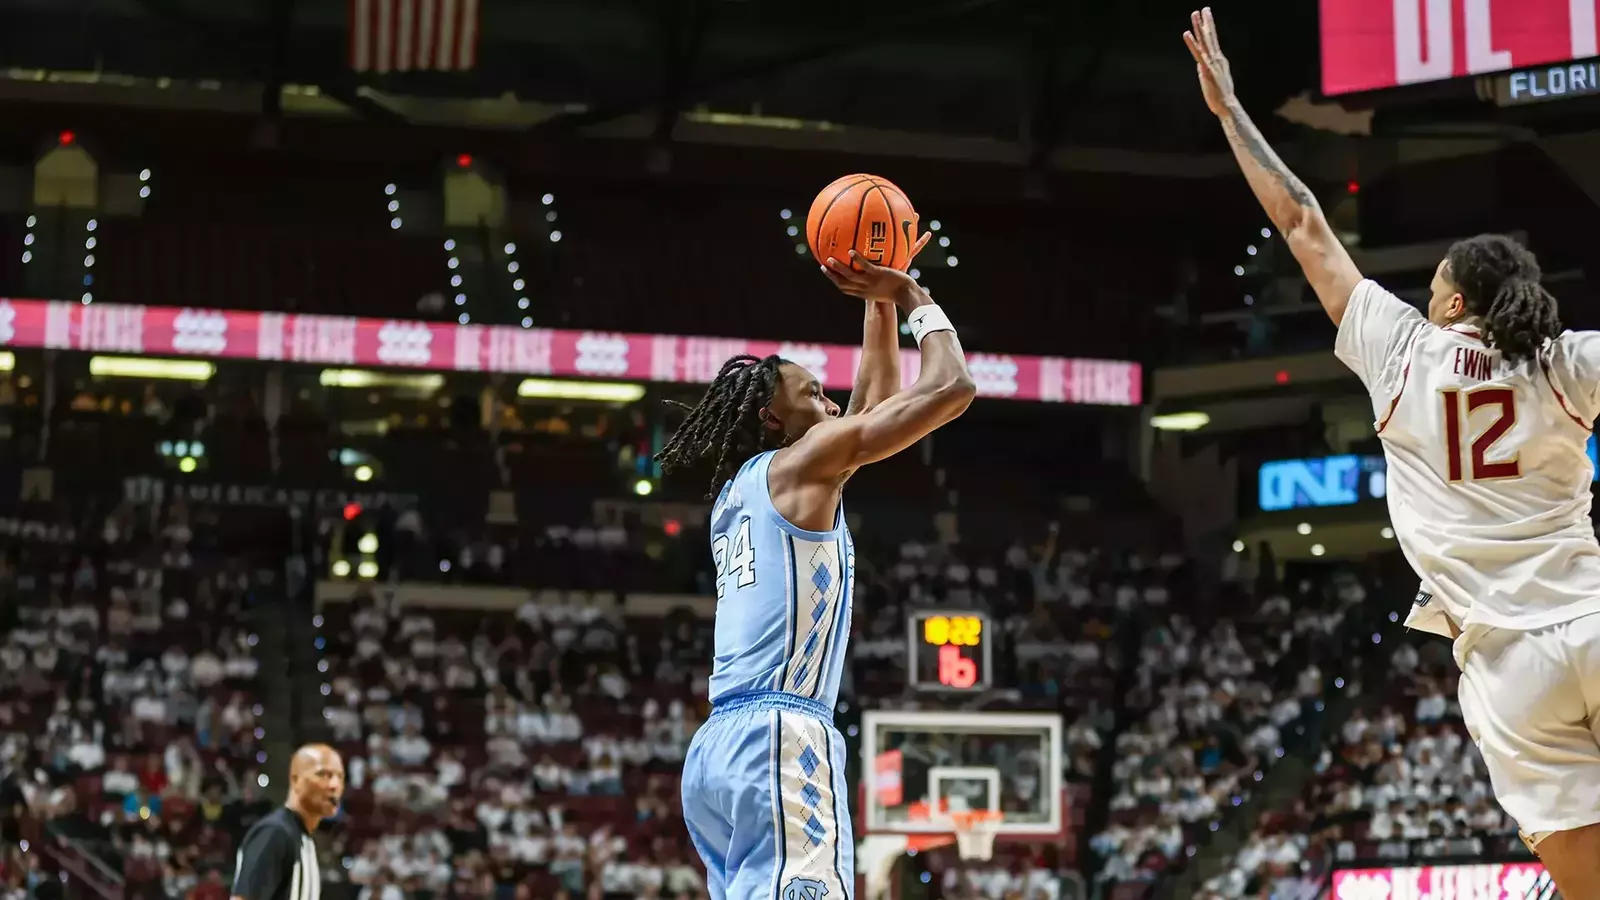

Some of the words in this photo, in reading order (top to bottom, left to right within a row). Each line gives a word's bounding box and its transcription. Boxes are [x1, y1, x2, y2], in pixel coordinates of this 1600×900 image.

[1509, 63, 1597, 99] FLORI
[868, 221, 886, 266] ELIT
[1453, 347, 1493, 381] EWIN
[1440, 386, 1524, 484] 12
[712, 516, 756, 601] 24
